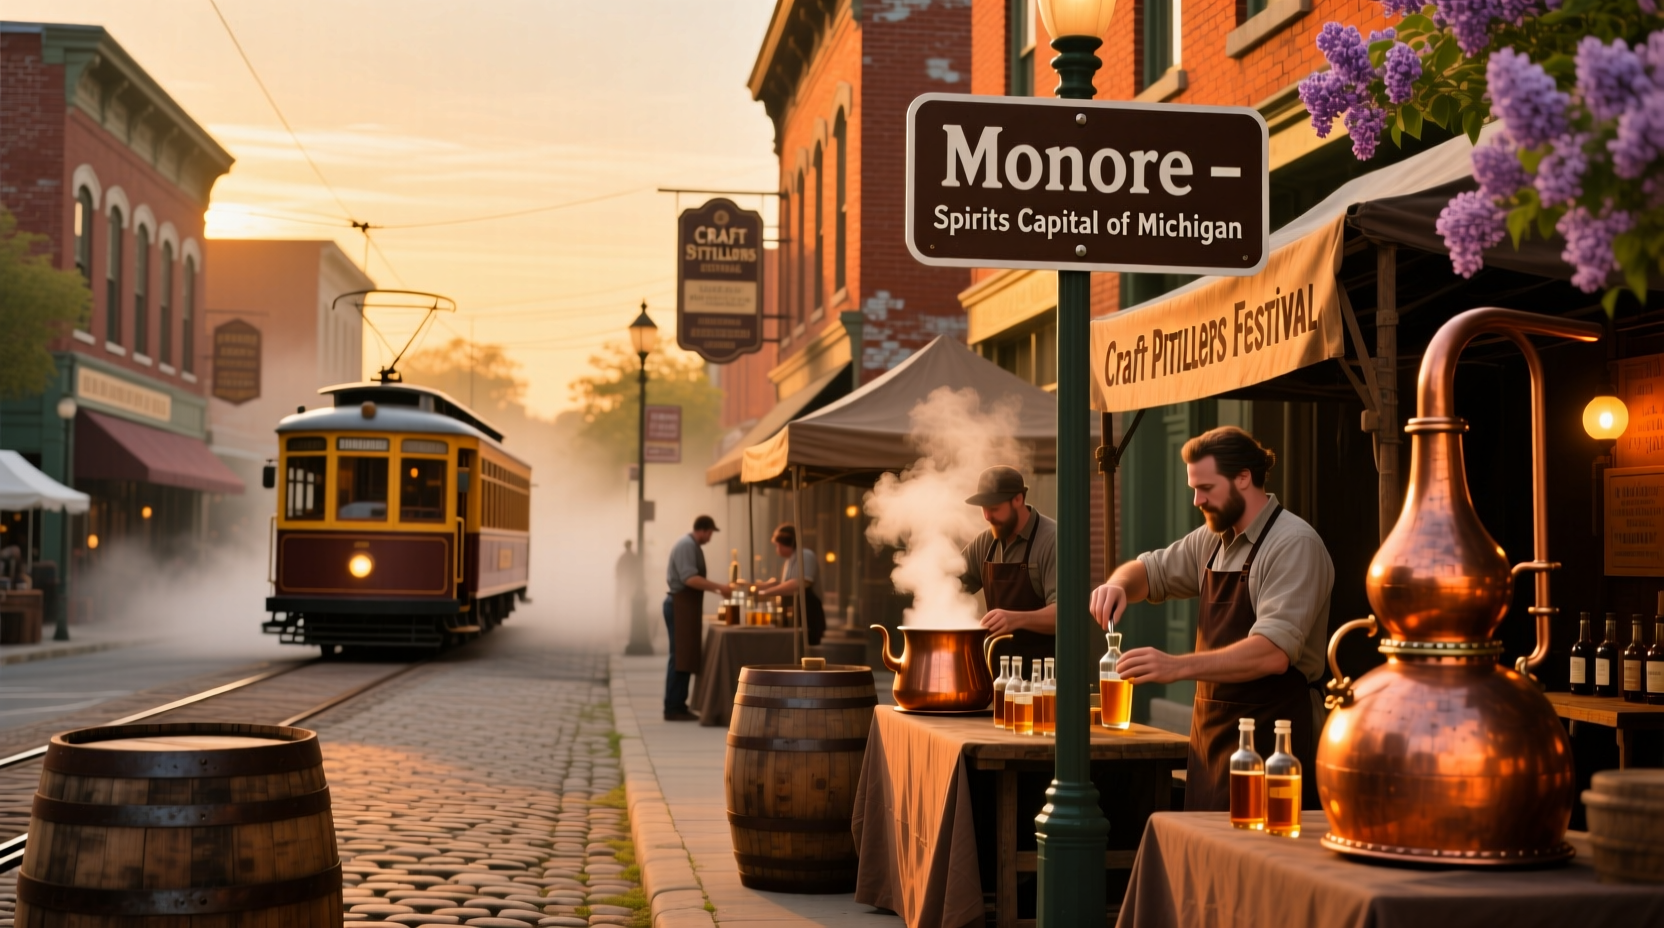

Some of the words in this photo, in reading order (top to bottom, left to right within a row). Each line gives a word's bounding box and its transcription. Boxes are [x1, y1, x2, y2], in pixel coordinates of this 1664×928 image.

[941, 124, 1193, 196] Monore
[694, 225, 748, 245] CRAFT
[933, 204, 1010, 236] Spirits
[1017, 207, 1098, 240] Capital
[1107, 211, 1130, 236] of
[1138, 212, 1242, 245] Michigan
[1105, 334, 1148, 387] Craft
